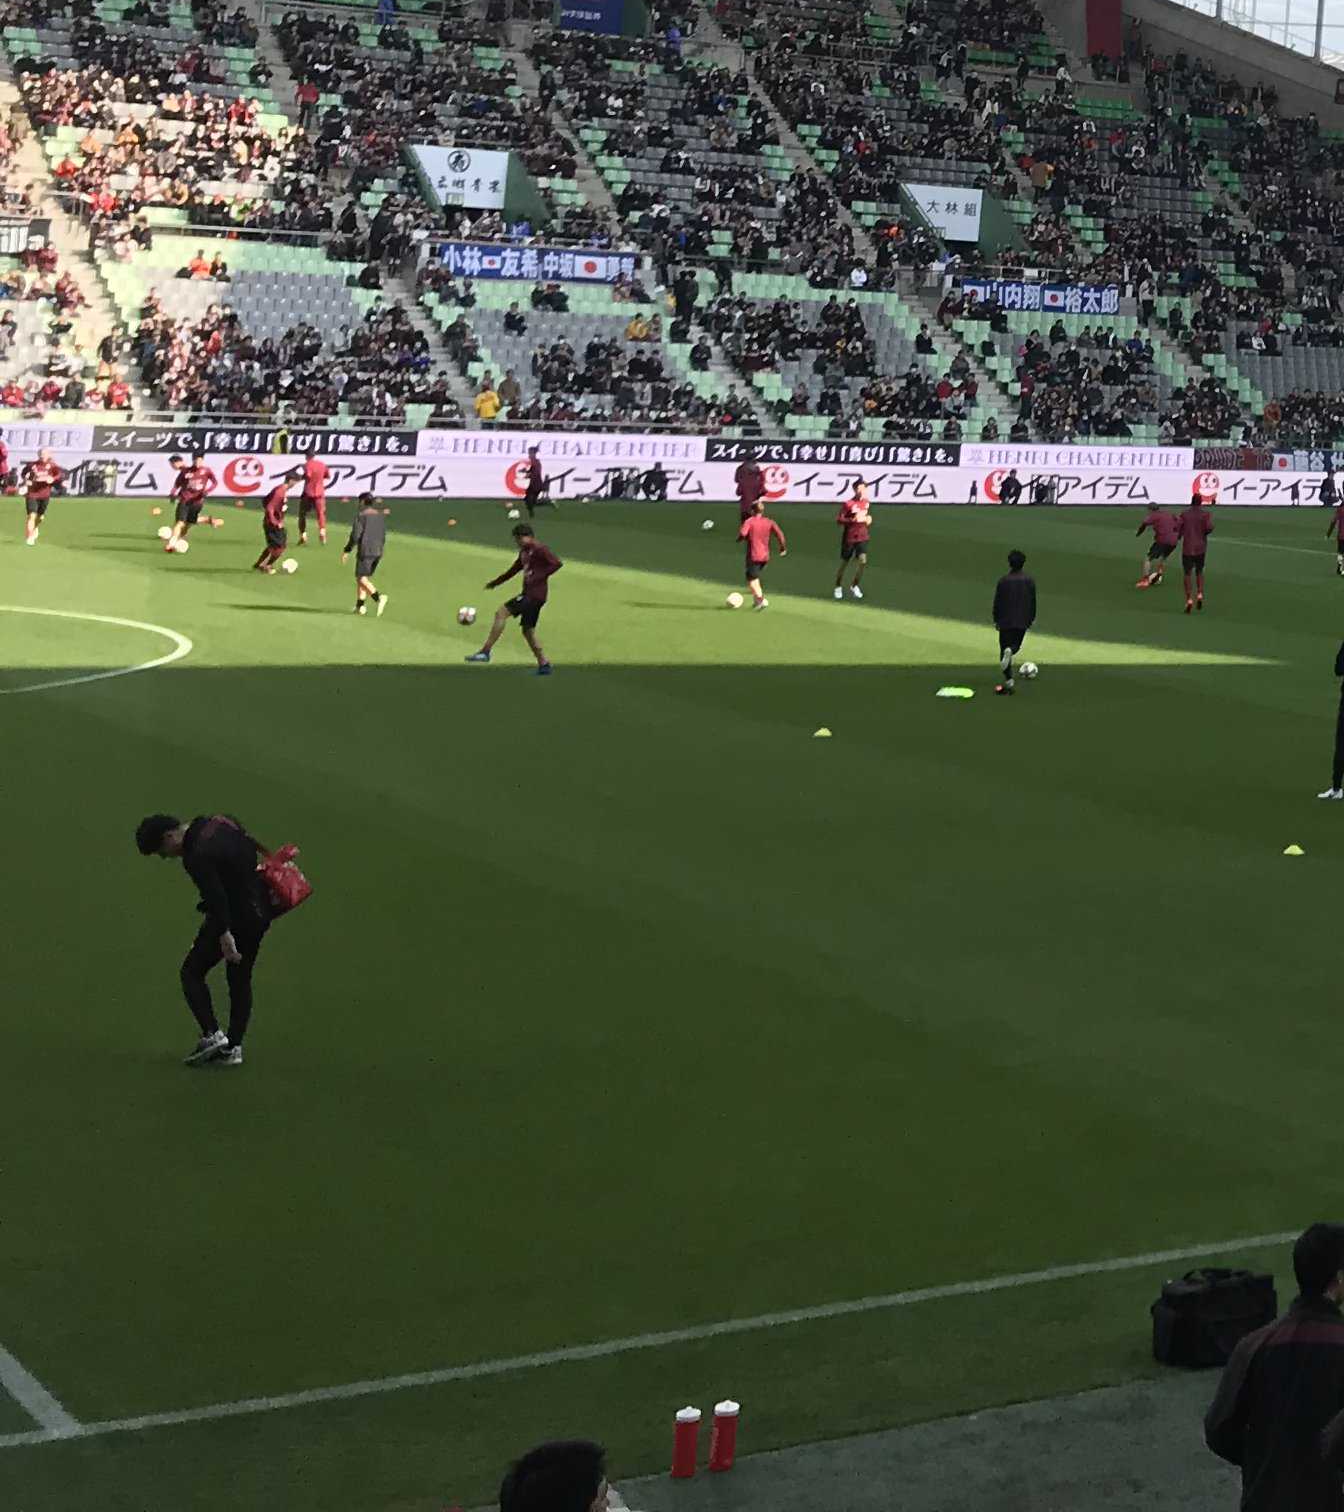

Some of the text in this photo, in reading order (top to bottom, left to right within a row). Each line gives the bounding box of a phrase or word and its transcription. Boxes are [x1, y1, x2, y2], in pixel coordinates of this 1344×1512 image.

[926, 199, 977, 217] 大林組
[443, 244, 482, 276] 小林
